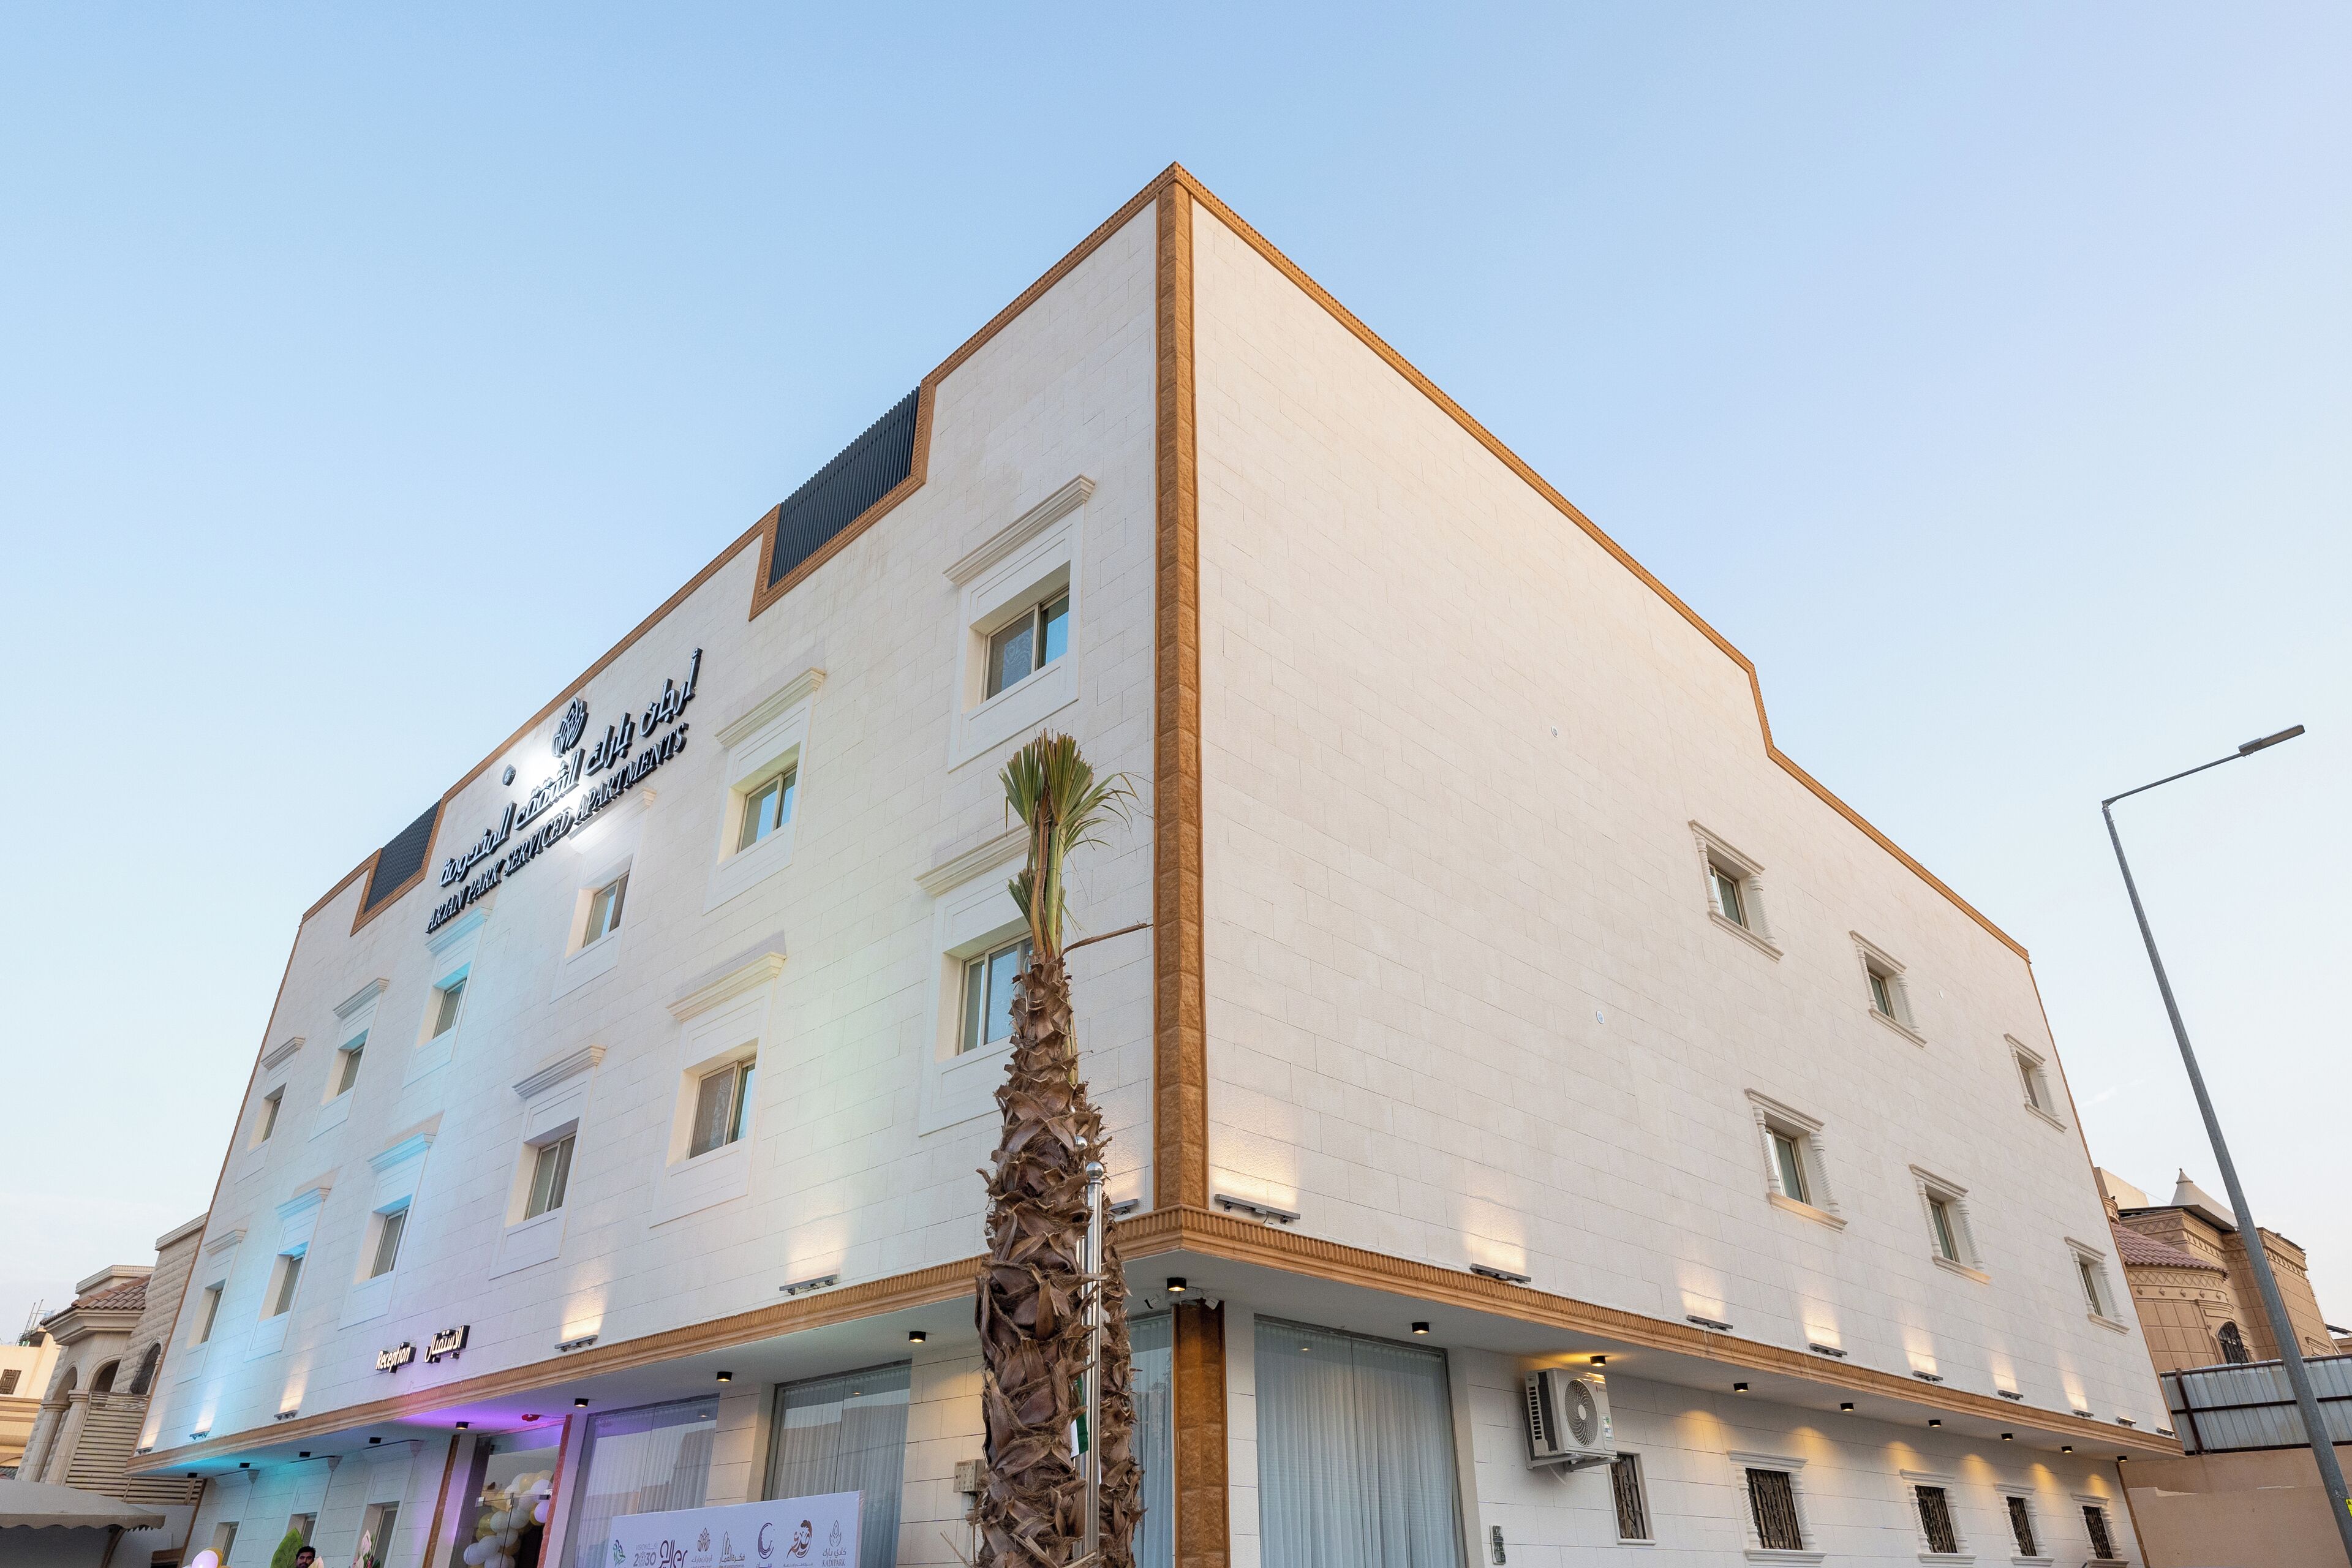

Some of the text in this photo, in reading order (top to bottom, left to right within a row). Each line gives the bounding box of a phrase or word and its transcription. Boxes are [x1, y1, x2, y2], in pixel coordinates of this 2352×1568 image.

[639, 647, 703, 738] أرجان
[584, 712, 636, 777] بارك
[426, 722, 690, 934] ARJAN PARK SERVICED APARTMENTS
[439, 801, 517, 888] المخدومة
[375, 1341, 417, 1374] Reception
